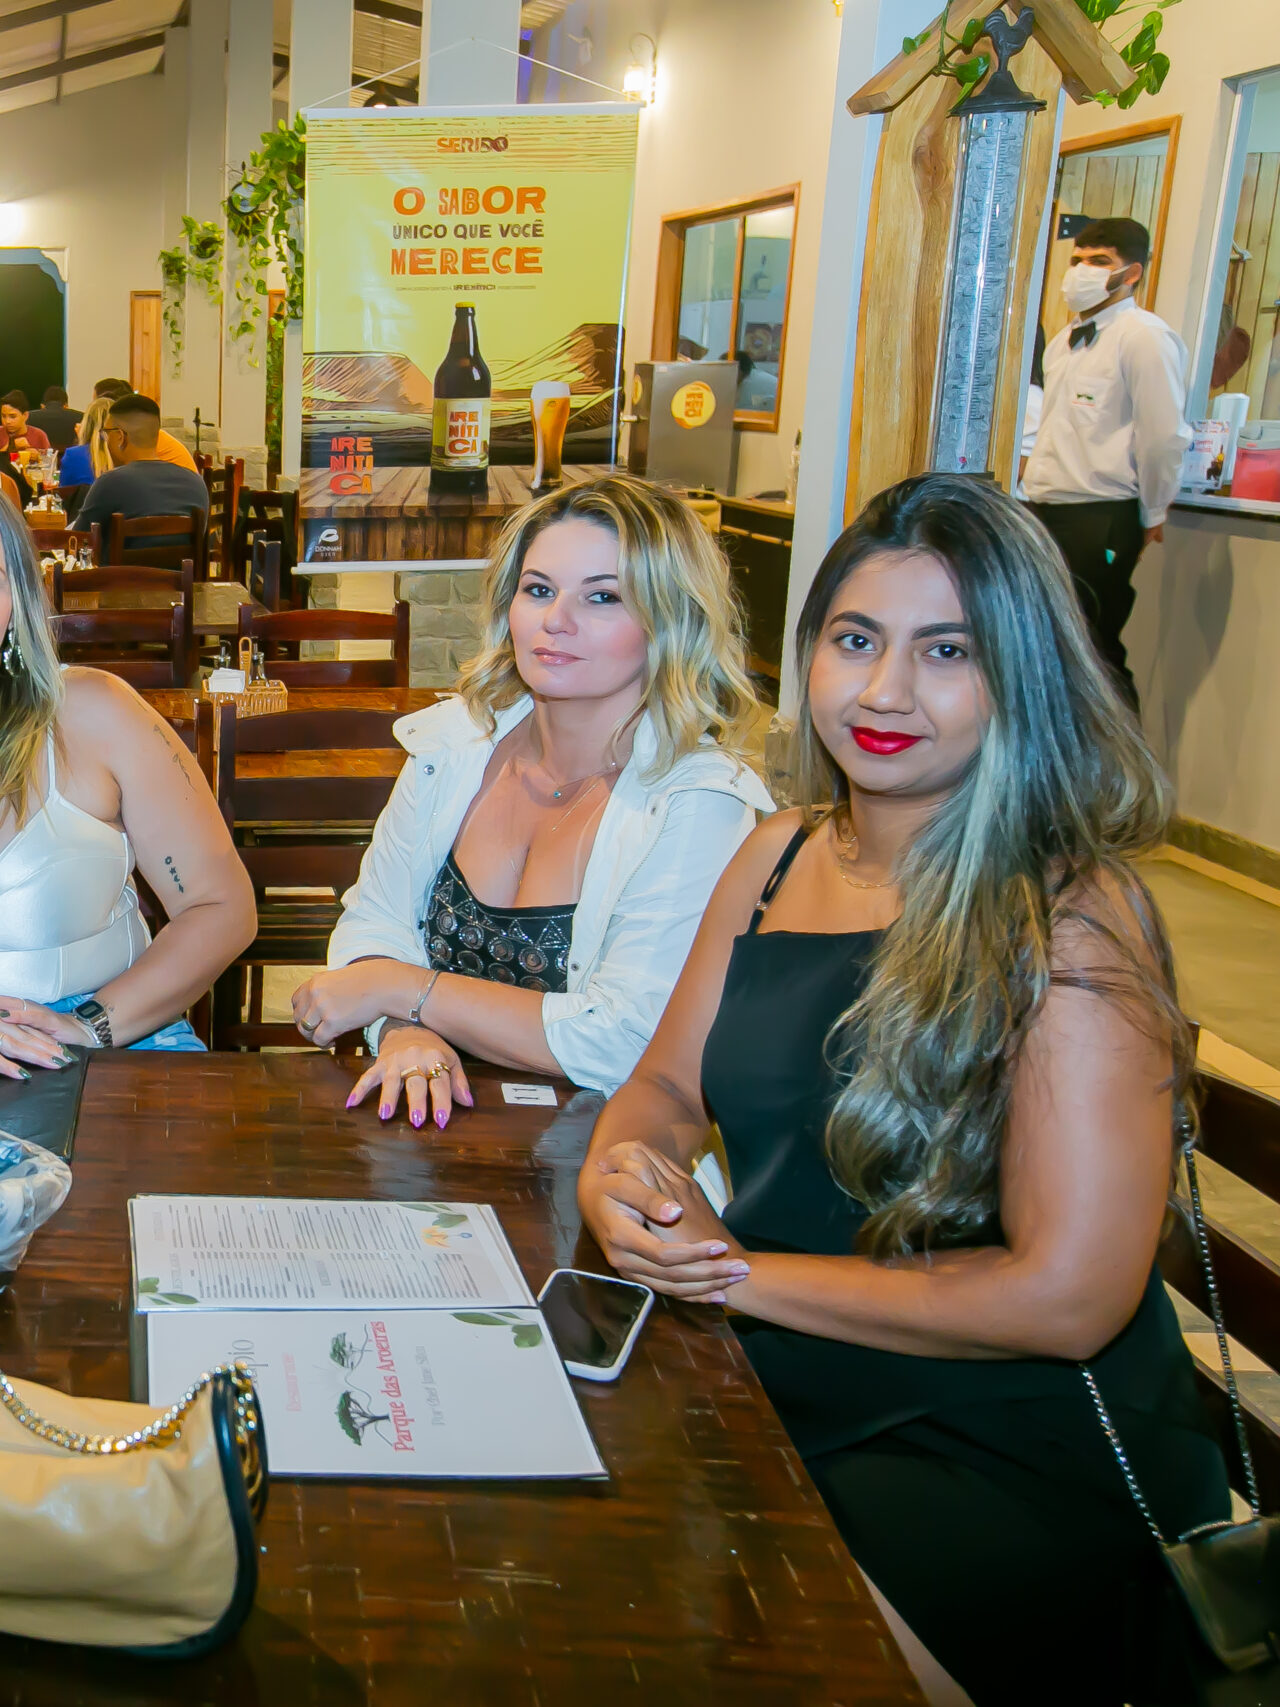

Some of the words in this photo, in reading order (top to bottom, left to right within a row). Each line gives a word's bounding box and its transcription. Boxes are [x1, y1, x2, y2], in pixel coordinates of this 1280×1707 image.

[393, 187, 426, 216] O
[438, 185, 547, 216] SABOR
[392, 222, 448, 239] ÚNICO
[453, 223, 492, 240] QUE
[499, 219, 545, 238] VOCÊ
[391, 246, 543, 276] MERECE
[331, 436, 373, 452] ARE
[329, 473, 373, 495] CA
[368, 1321, 397, 1372] Aroeiras
[381, 1375, 404, 1399] das
[389, 1401, 416, 1452] Parque
